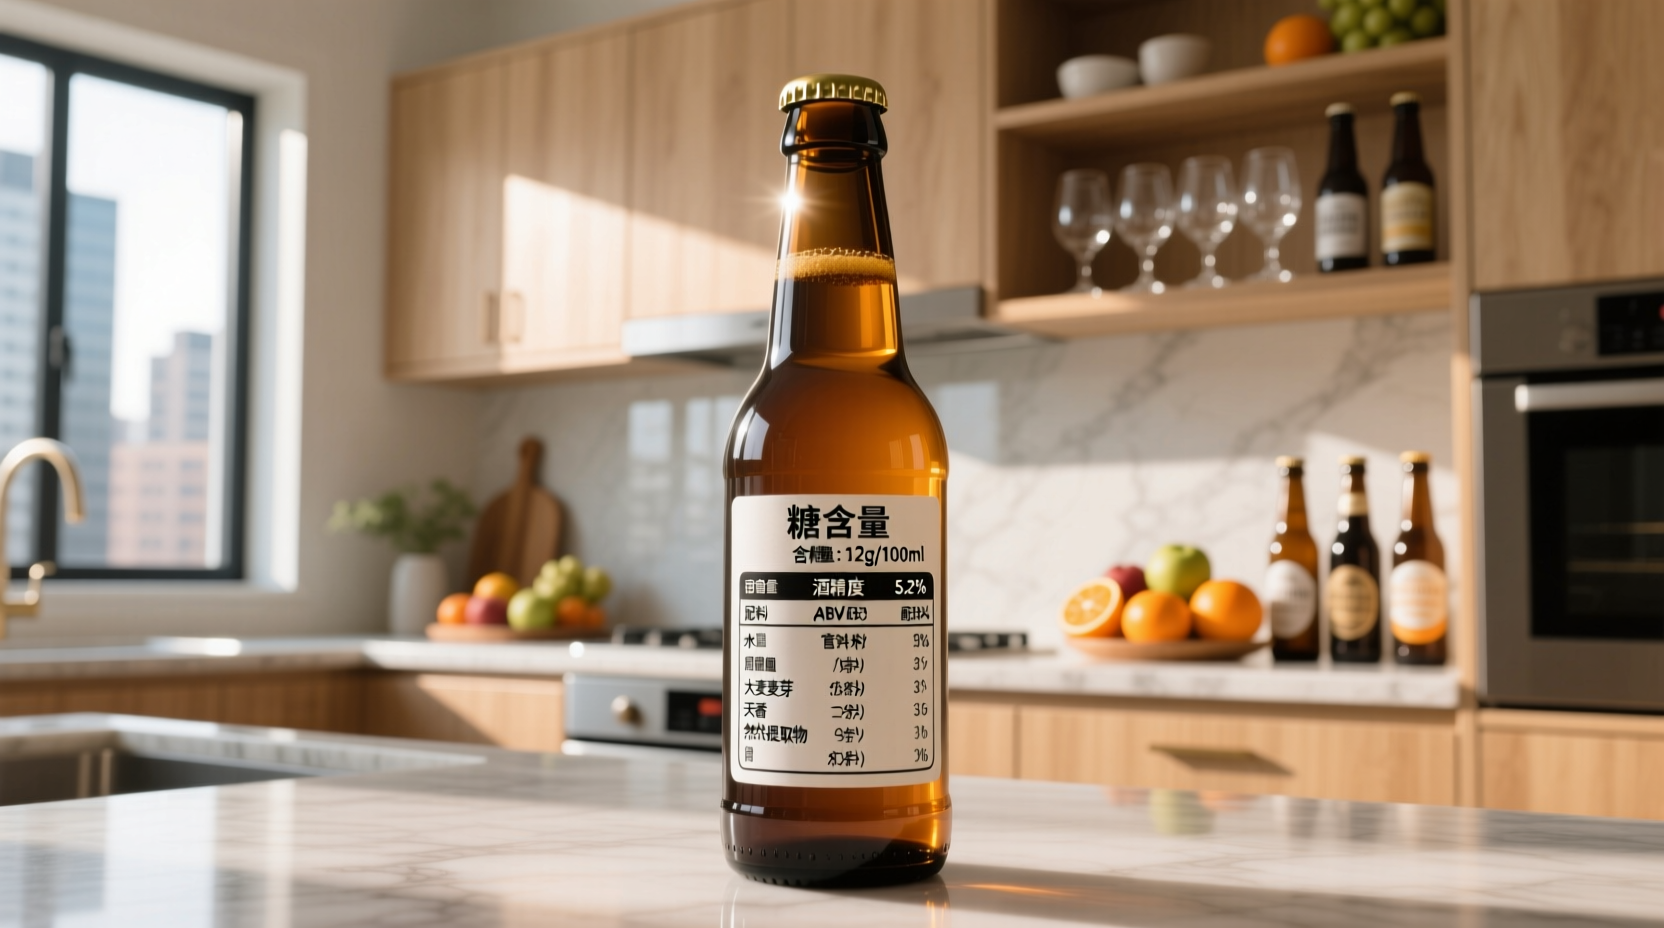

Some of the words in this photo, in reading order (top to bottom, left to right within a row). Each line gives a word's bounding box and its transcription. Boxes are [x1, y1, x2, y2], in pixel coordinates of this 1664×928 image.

[787, 504, 890, 539] 糖含量
[894, 579, 927, 595] 5.2%
